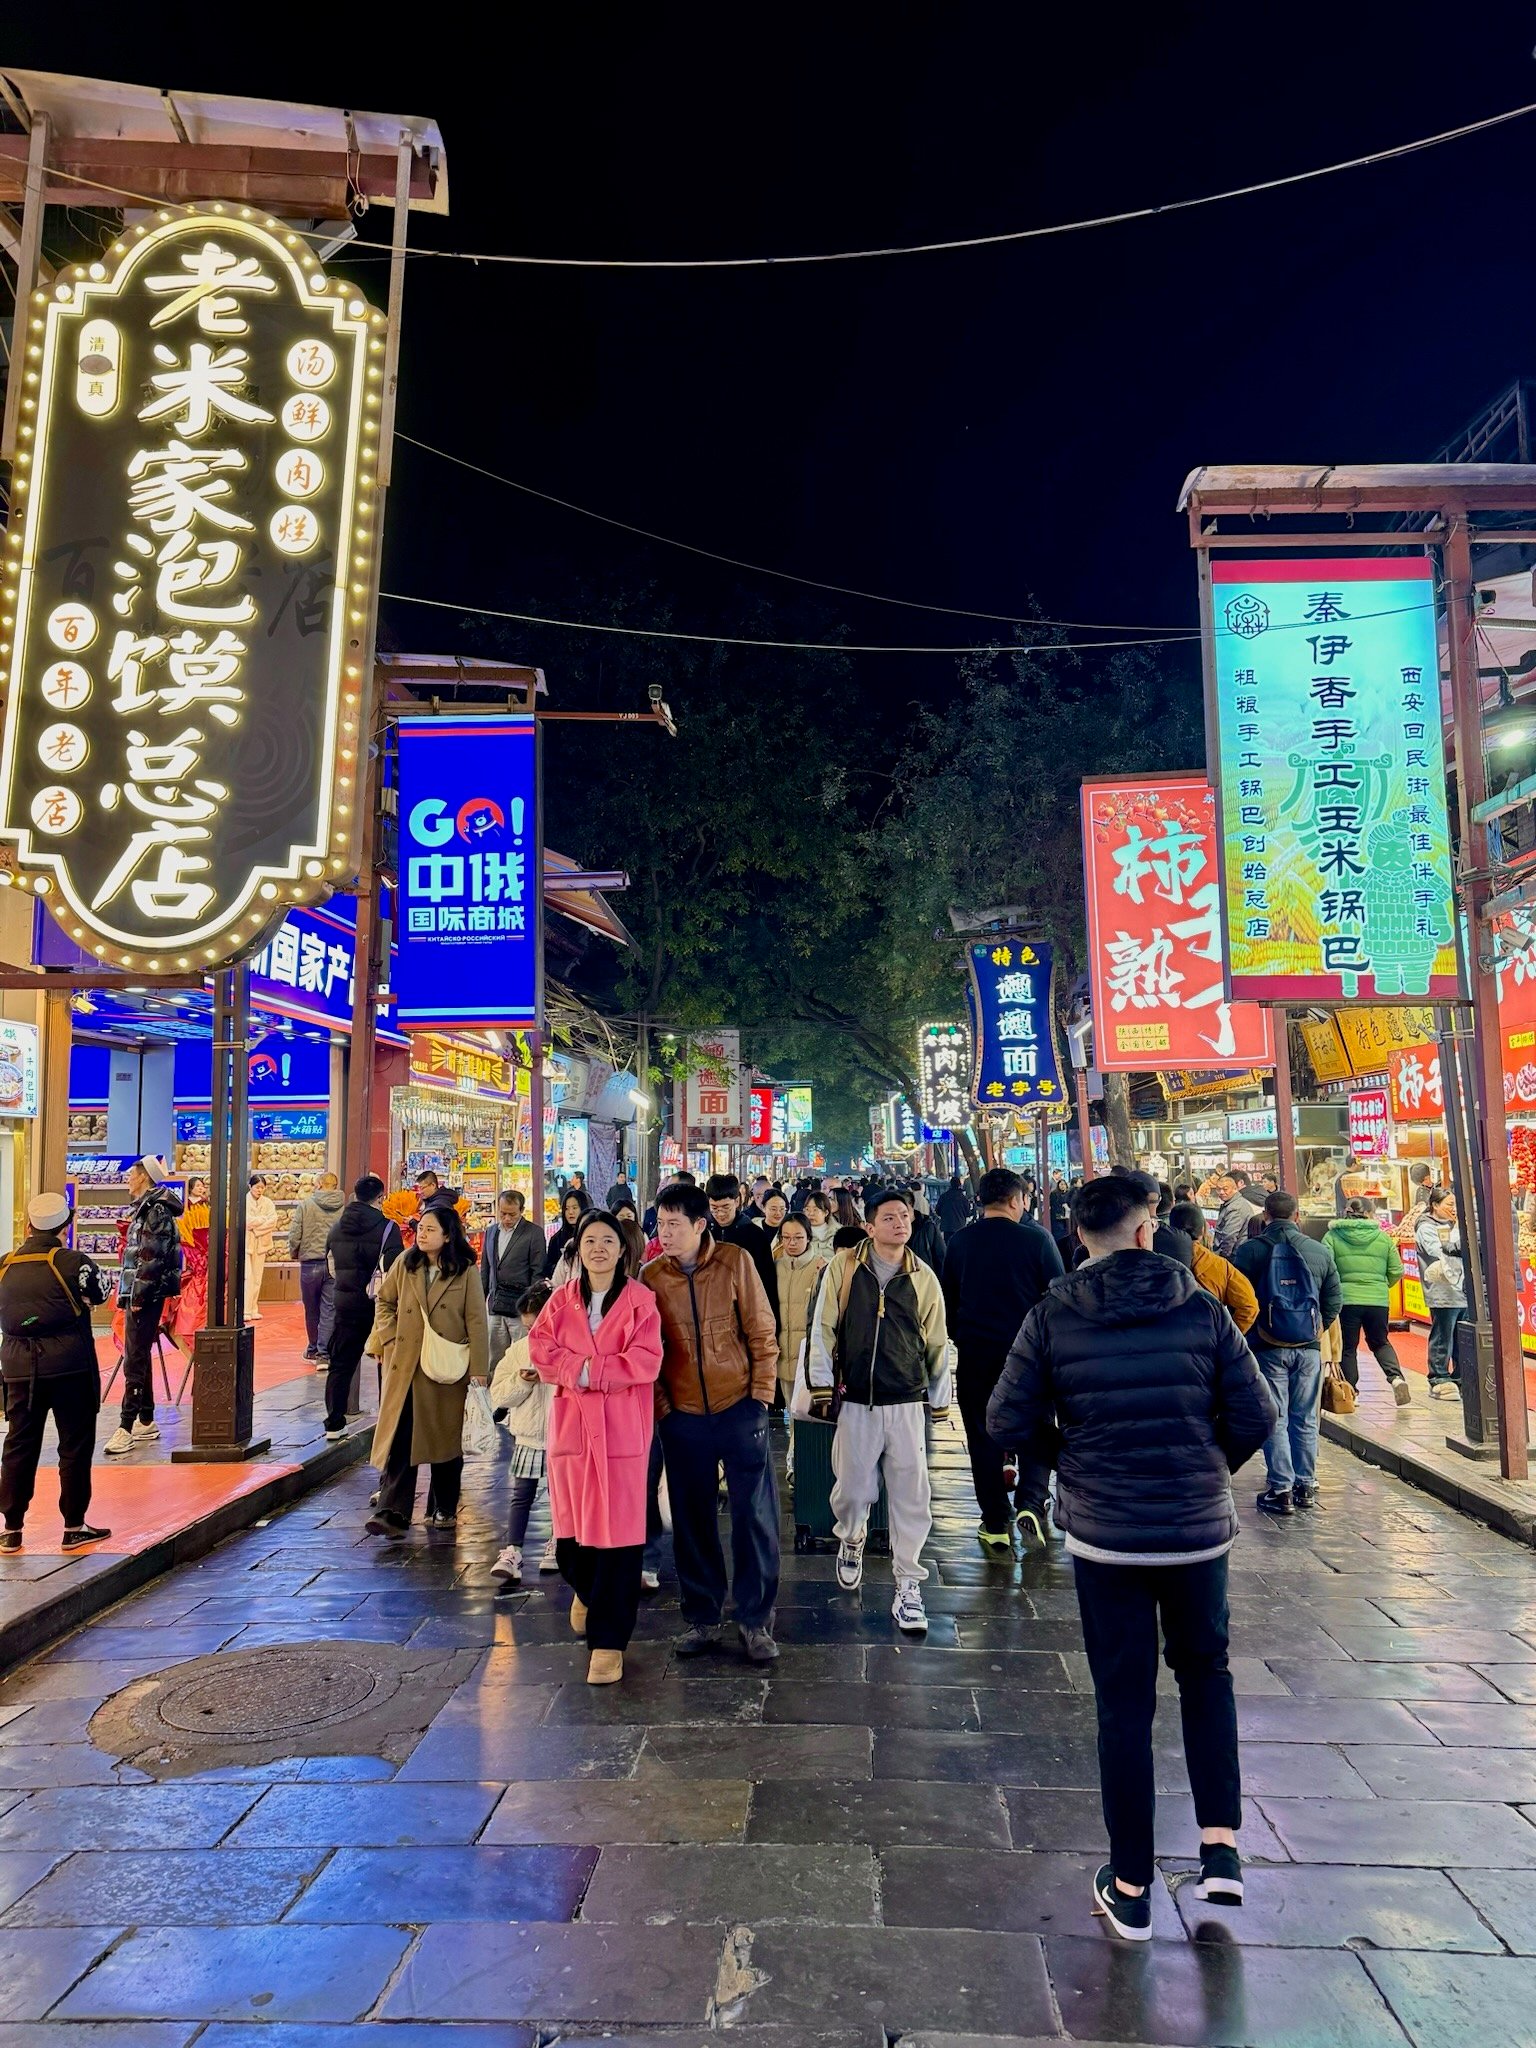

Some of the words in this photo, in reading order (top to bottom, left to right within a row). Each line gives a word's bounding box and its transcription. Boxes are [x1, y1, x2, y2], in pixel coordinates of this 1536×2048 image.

[88, 336, 105, 397] 清真
[278, 345, 326, 543] 汤鲜肉烂
[91, 242, 277, 920] 老米家泡馍总店
[36, 615, 86, 828] 百年老店
[1304, 591, 1369, 972] 秦伊香手工玉米锅巴
[1235, 669, 1270, 938] 粗粮手工锅巴创始总店
[1400, 667, 1440, 938] 西安回民街最佳伴手礼
[409, 851, 524, 903] 中俄
[409, 905, 525, 932] 国际商城
[991, 946, 1040, 966] 特色
[298, 1116, 317, 1125] AR
[986, 1080, 1056, 1098] 老字号
